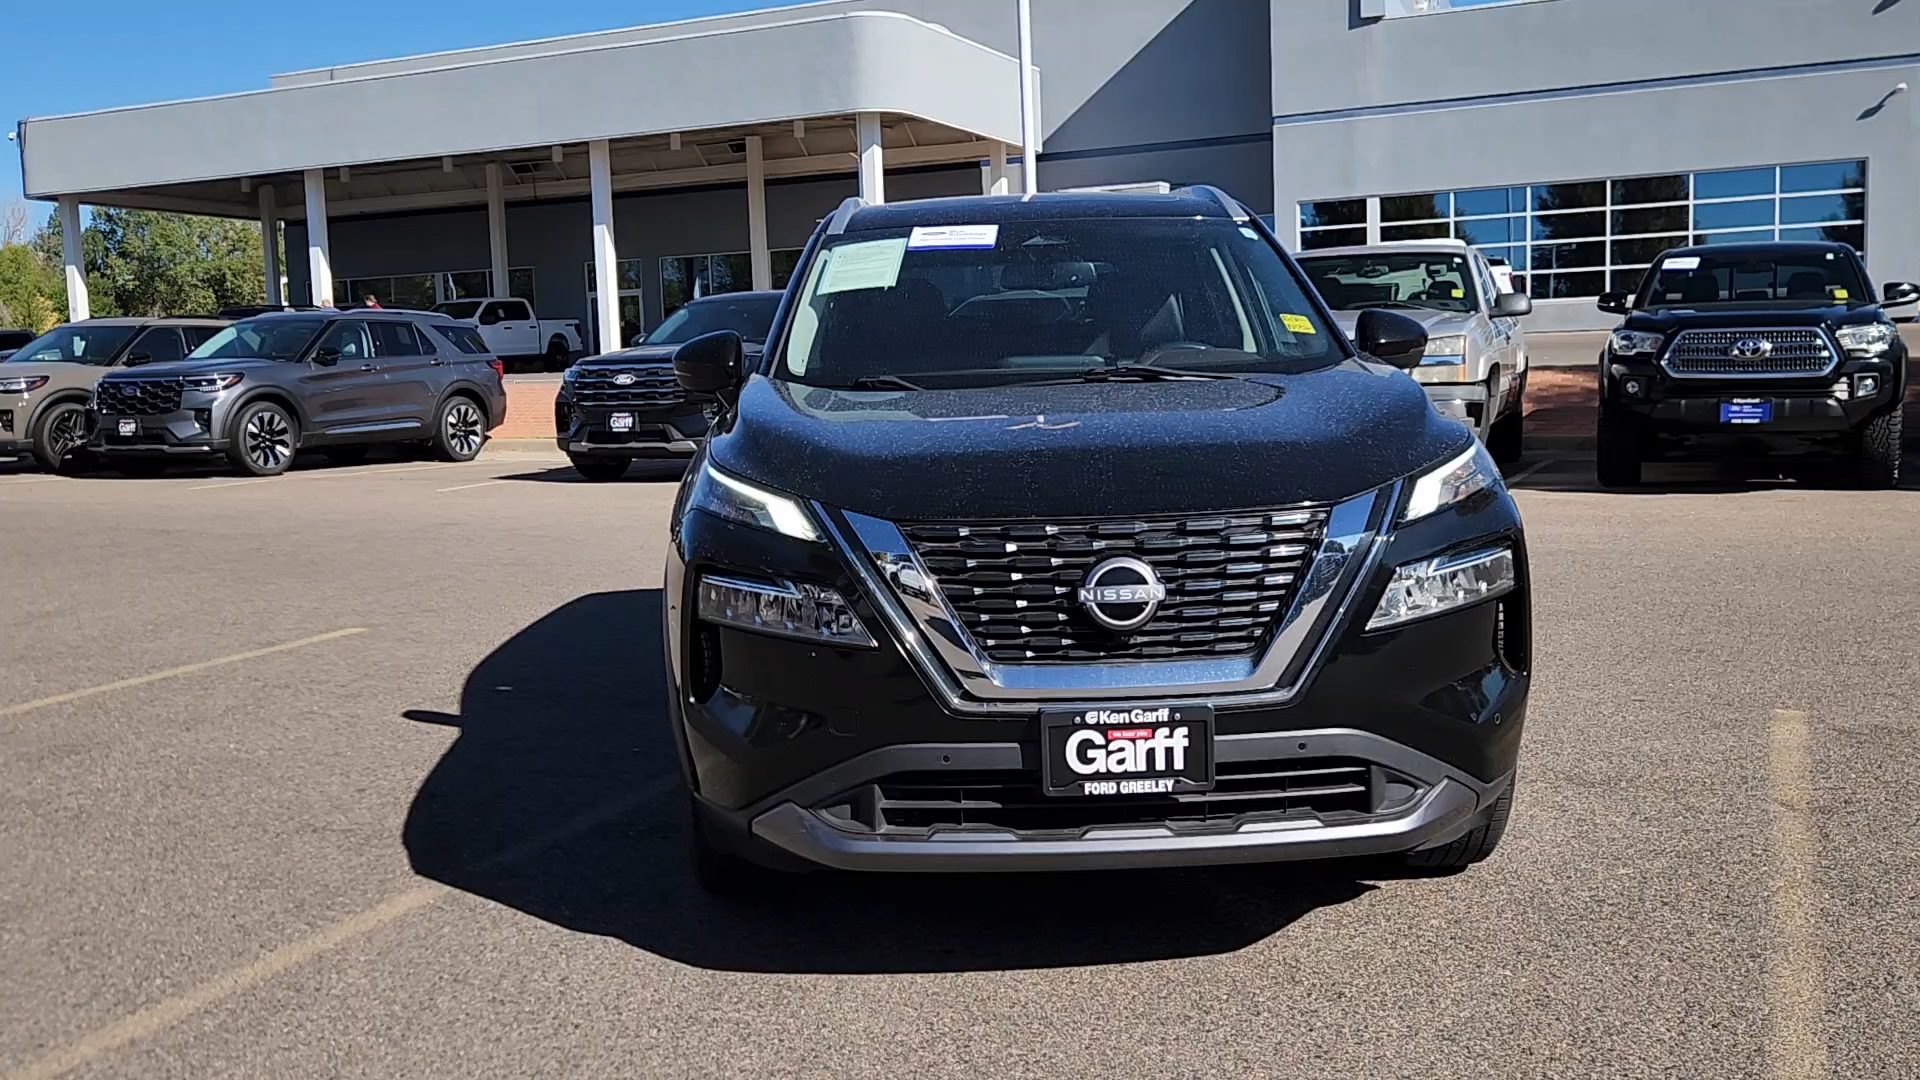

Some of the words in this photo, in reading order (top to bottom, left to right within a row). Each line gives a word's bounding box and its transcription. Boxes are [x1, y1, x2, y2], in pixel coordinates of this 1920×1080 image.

[611, 416, 633, 427] Garff
[1081, 588, 1162, 600] NISSAN
[1100, 710, 1129, 724] Ken
[1131, 708, 1169, 722] Garff
[1065, 727, 1189, 774] Garff
[1084, 782, 1117, 794] FORD
[1120, 780, 1174, 794] GREELEY
